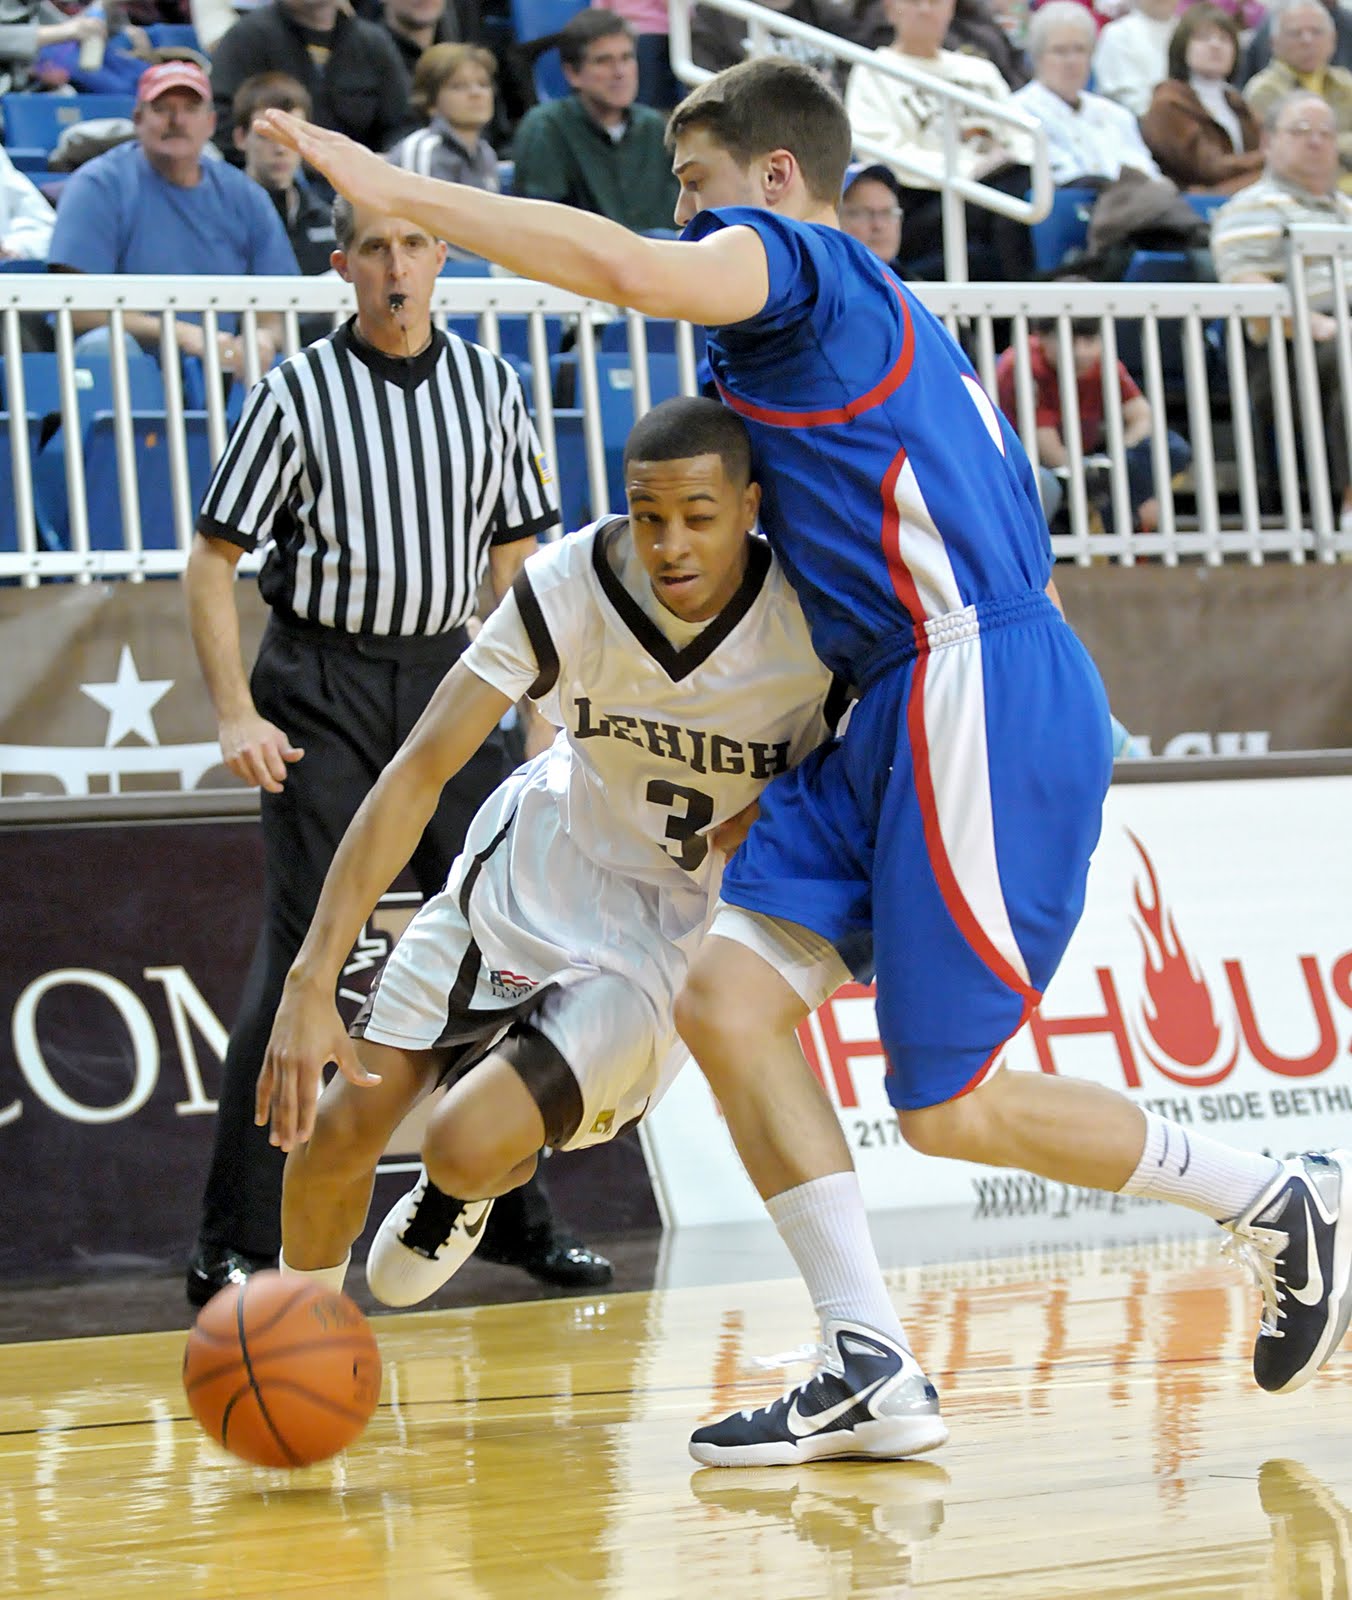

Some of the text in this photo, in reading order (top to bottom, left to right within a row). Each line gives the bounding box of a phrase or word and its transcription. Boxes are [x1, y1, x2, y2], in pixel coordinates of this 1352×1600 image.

[574, 697, 790, 779] LEHIGH
[646, 779, 714, 871] 3
[1200, 1092, 1264, 1123] SIDE
